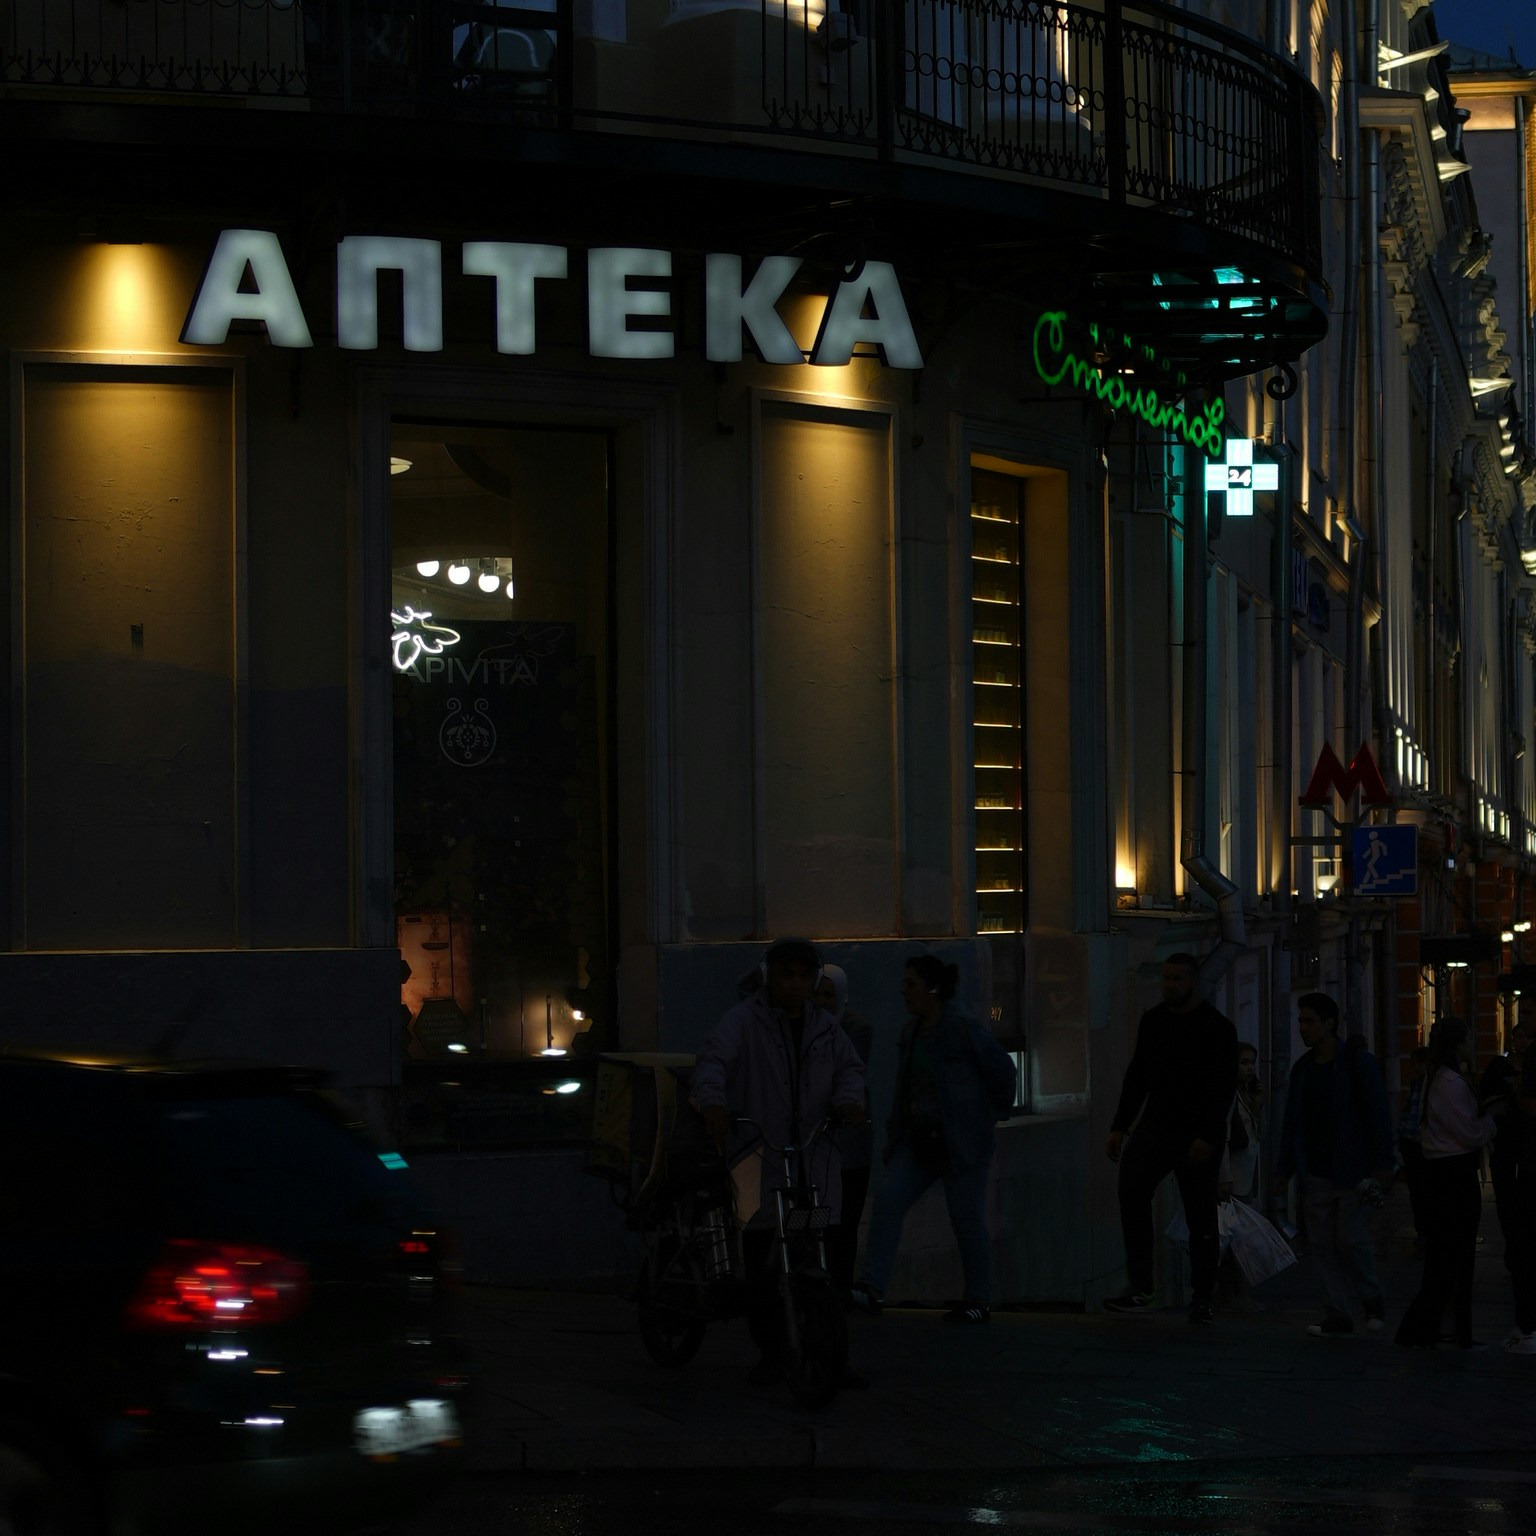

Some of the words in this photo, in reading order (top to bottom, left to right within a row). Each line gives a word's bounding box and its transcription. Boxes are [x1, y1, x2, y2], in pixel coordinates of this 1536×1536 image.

[179, 226, 926, 370] АПТЕКА
[1228, 468, 1252, 487] 24
[401, 655, 540, 686] APIVITA
